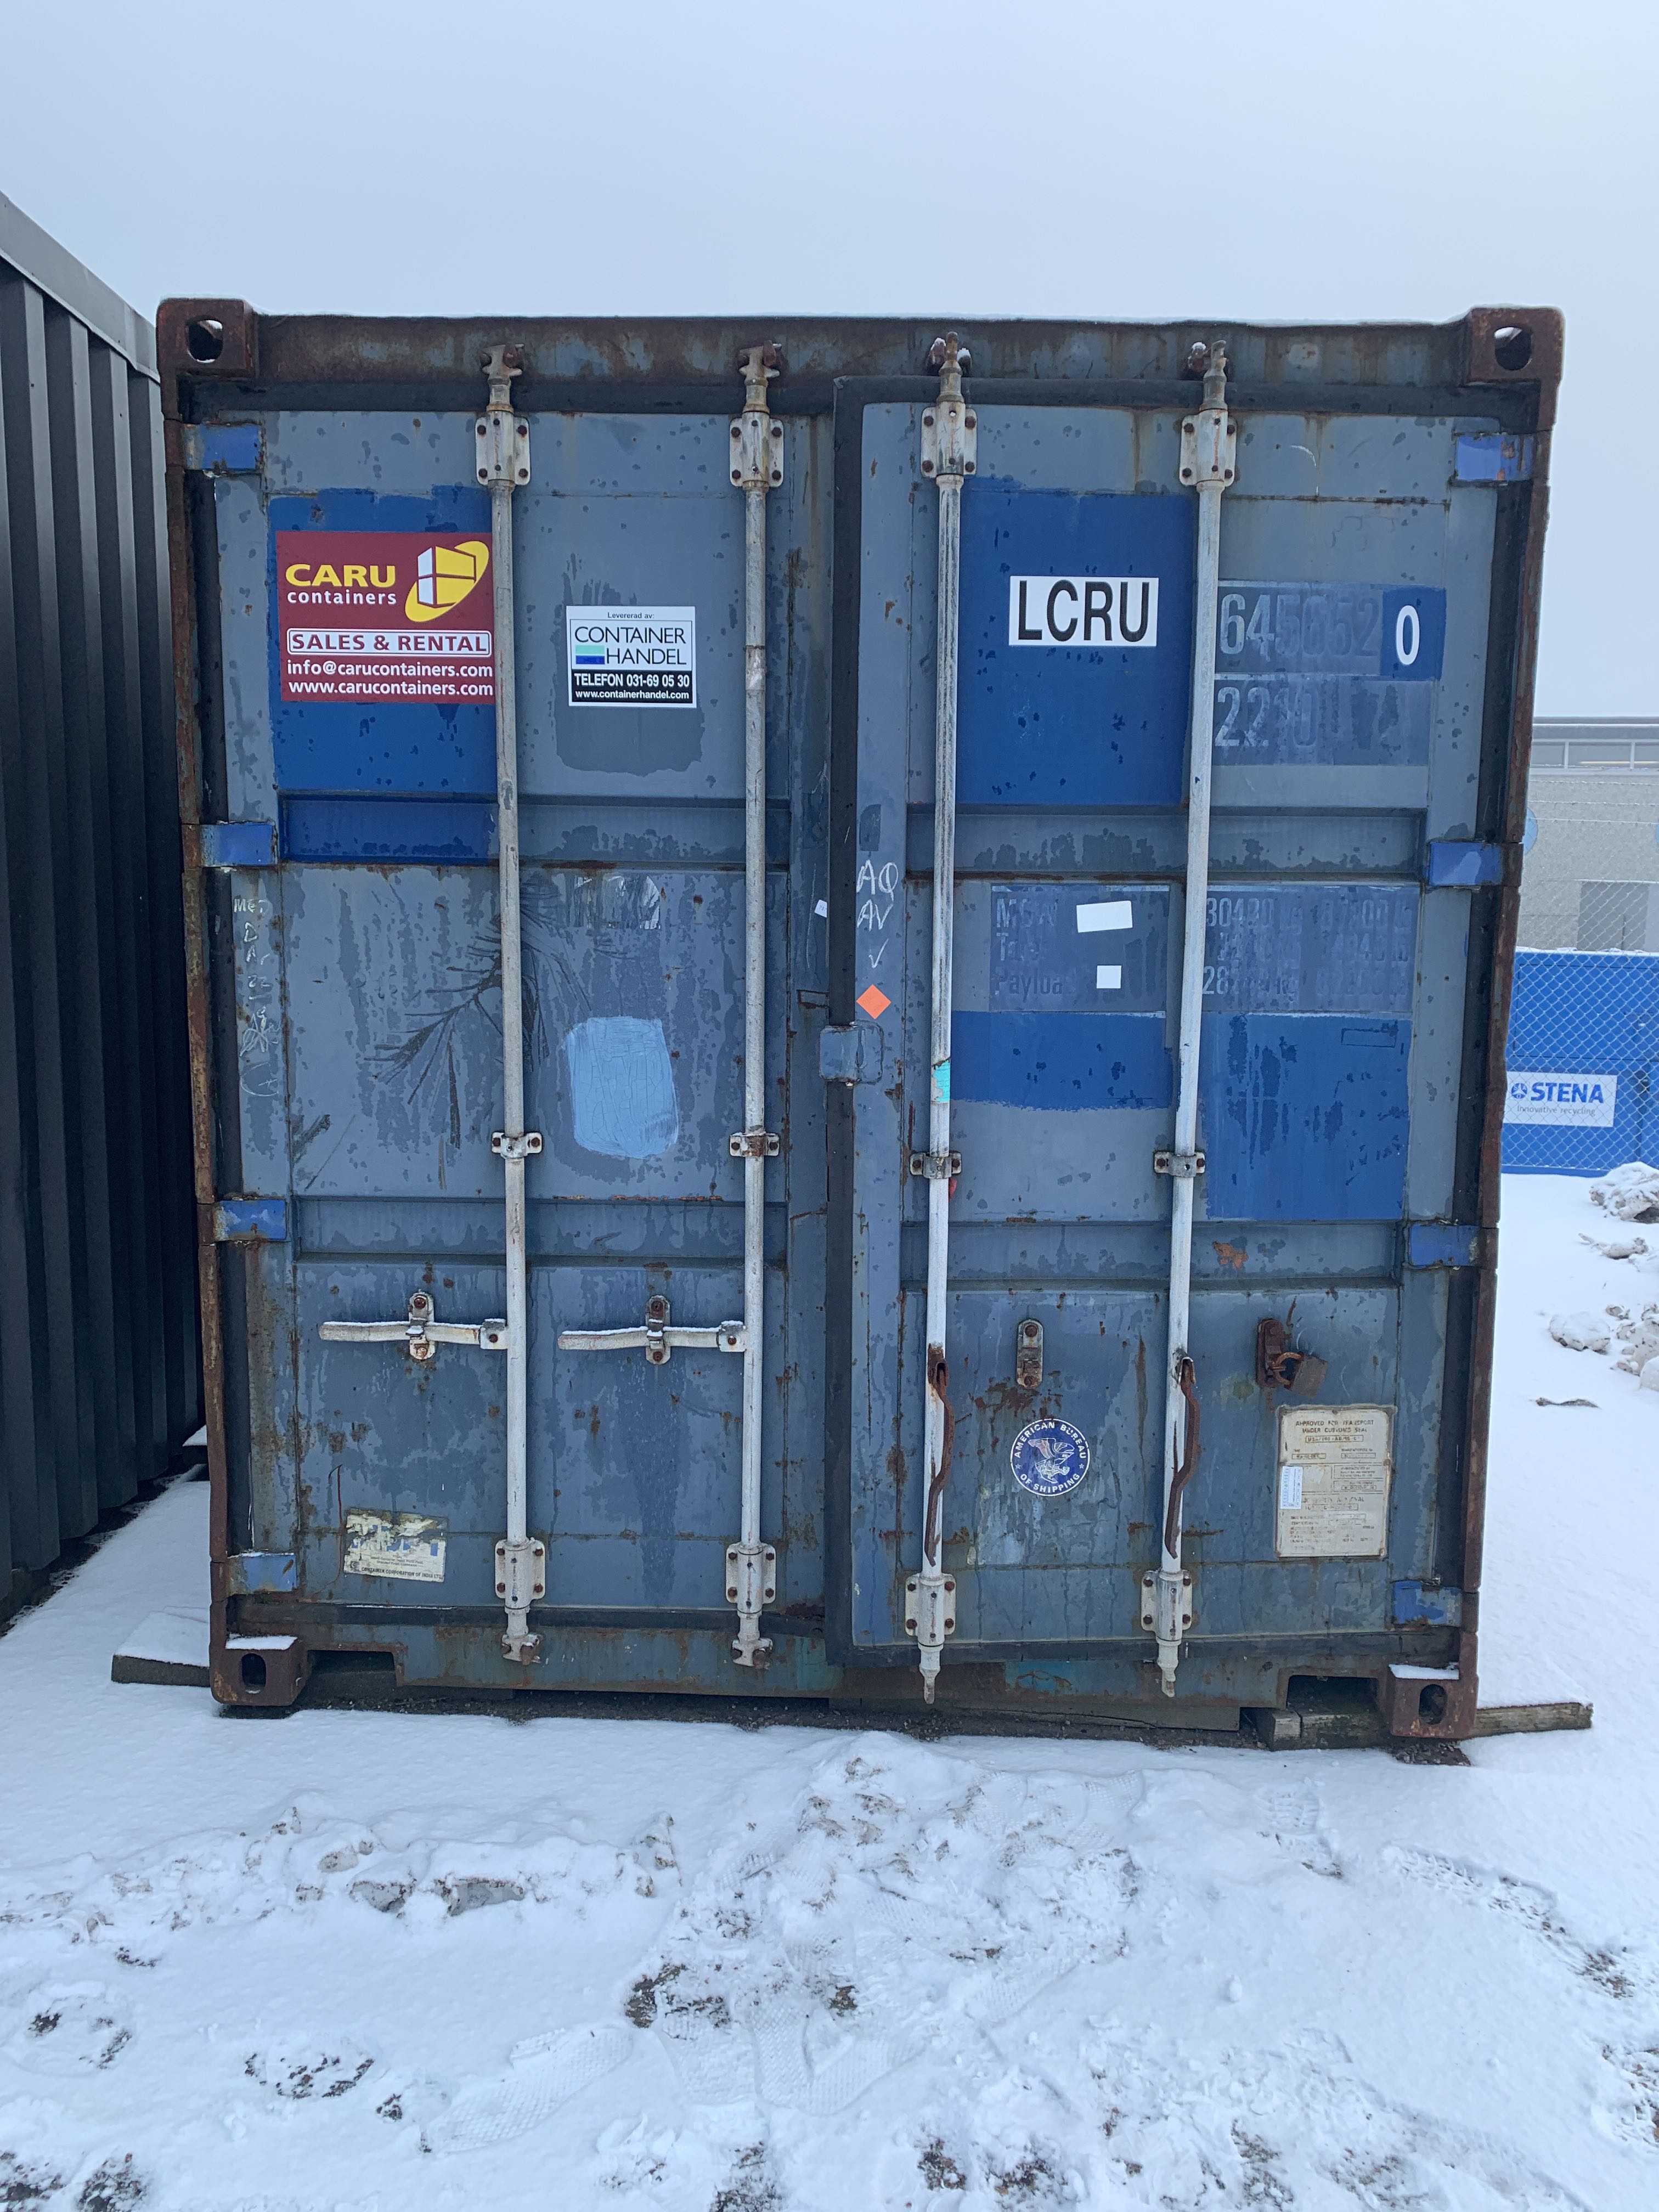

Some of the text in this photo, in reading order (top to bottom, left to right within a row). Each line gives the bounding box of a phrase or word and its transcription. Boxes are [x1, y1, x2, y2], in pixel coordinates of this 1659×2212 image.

[285, 563, 396, 588] CARU
[287, 589, 397, 604] containers
[1018, 580, 1150, 642] LCRU
[292, 633, 487, 652] SALES & RENTAL
[574, 626, 686, 644] CONTAINER
[1396, 605, 1420, 665] 0
[607, 648, 687, 665] HANDEL
[287, 659, 493, 677] info@carucontainers.com
[289, 680, 493, 696] www.carucontainers.com
[574, 673, 690, 687] TELEFON 031-69 05 30
[575, 690, 689, 699] www.containerhandel.com
[1531, 1082, 1604, 1103] STENA
[1517, 1105, 1596, 1116] Innovative recycling
[1014, 1421, 1087, 1459] AMERICAN BUREAU
[1020, 1472, 1080, 1493] OF SHIPPING
